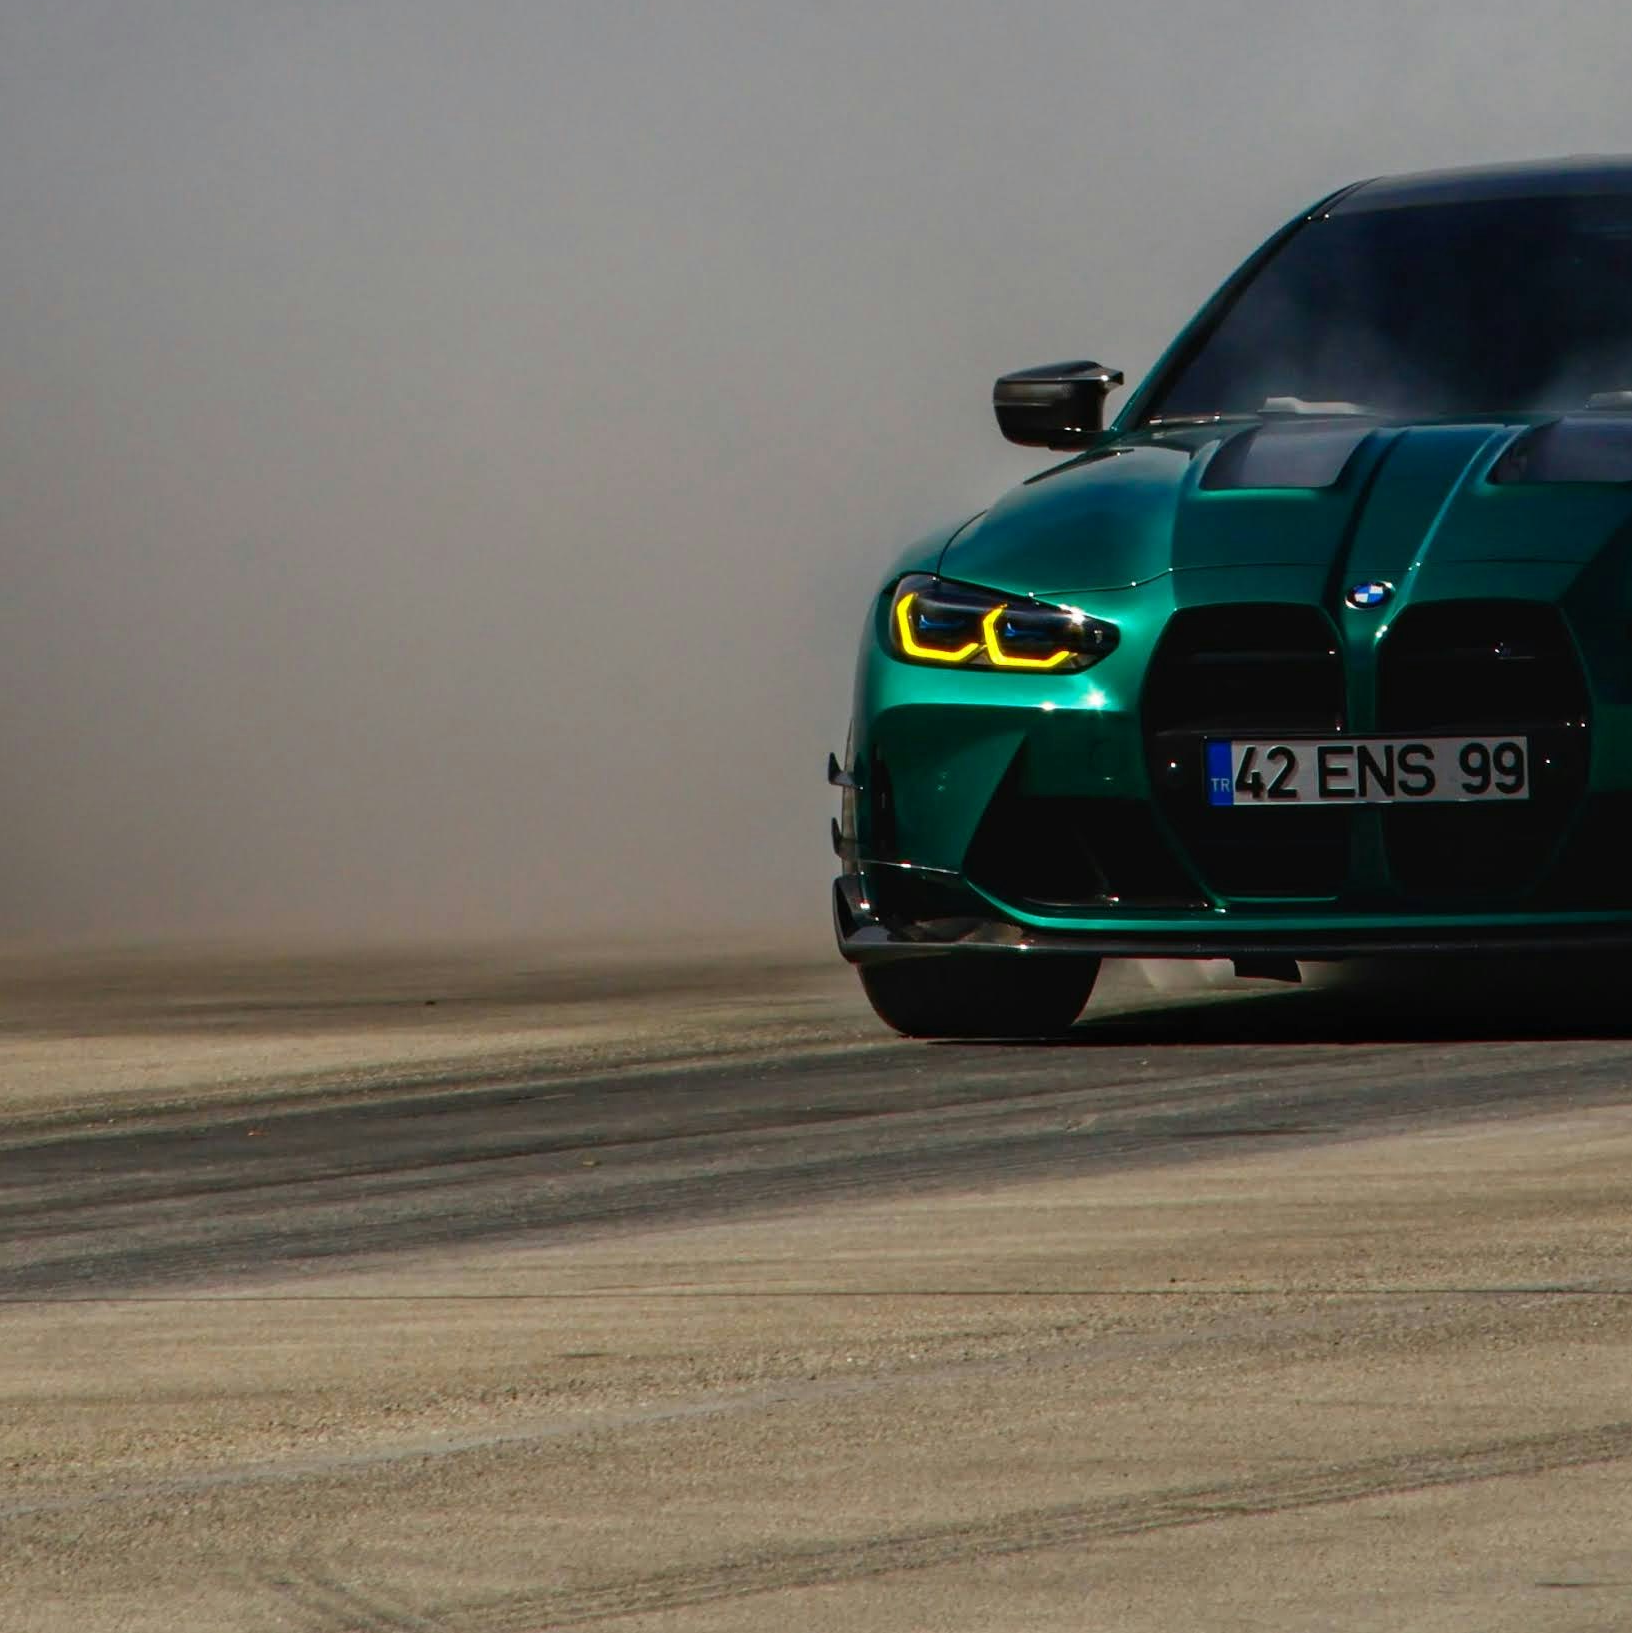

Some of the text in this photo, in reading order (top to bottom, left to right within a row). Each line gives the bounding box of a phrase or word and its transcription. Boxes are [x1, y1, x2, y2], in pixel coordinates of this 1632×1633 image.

[1210, 741, 1525, 799] TR 42 ENS 99
